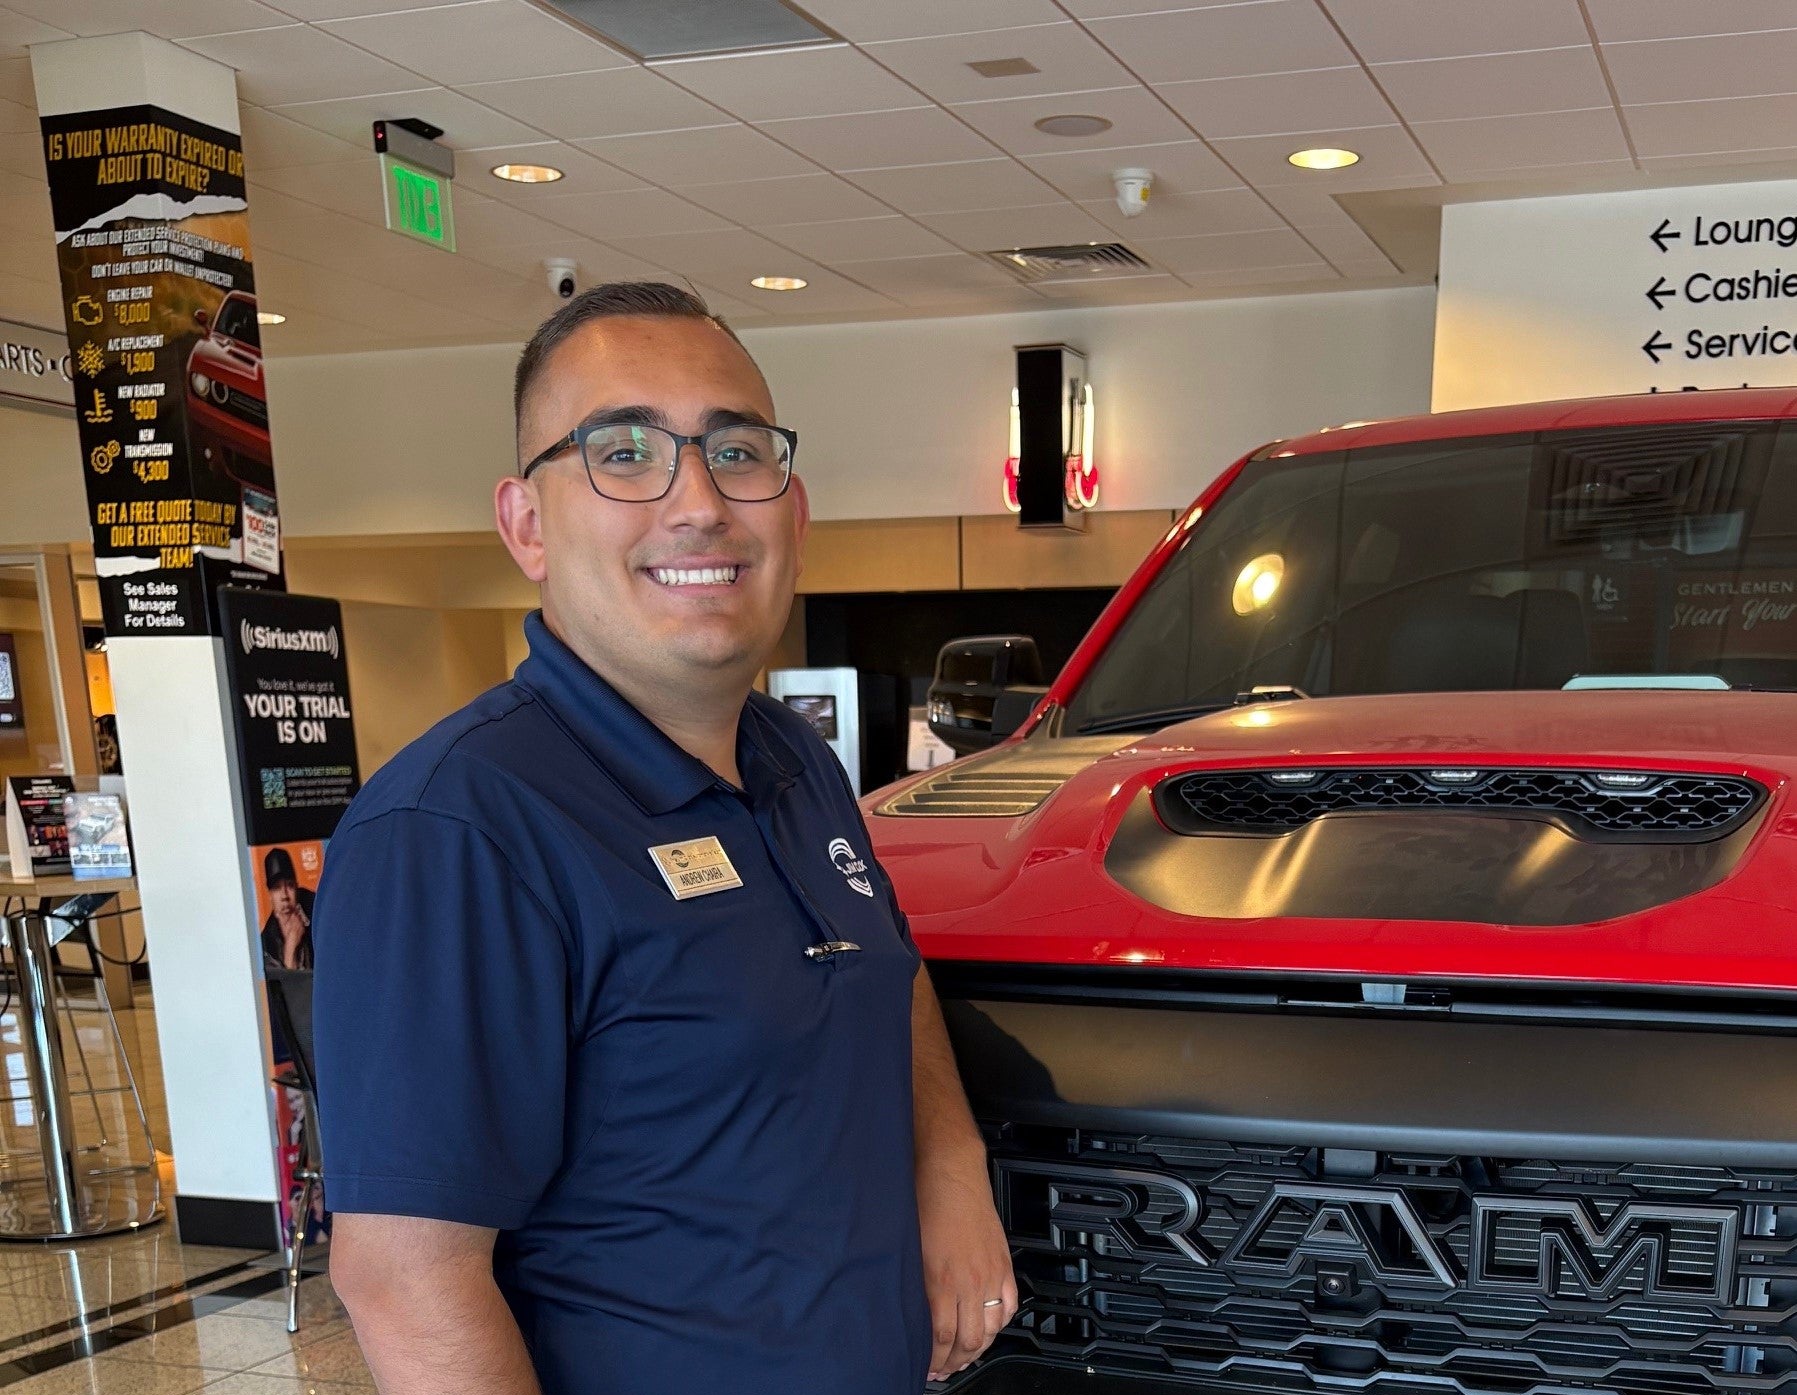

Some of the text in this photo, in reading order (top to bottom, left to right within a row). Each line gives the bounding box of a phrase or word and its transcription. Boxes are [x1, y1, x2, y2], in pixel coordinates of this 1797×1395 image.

[49, 123, 244, 178] IS YOUR WARRANTY EXPIRED OR
[97, 153, 209, 193] ABOUT TO EXPIRE?
[71, 233, 86, 248] ASK
[123, 227, 156, 243] EXTENDED
[149, 258, 163, 273] CAR
[114, 302, 150, 326] $8,000
[1685, 325, 1797, 360] Servic
[121, 351, 155, 375] $1,900
[118, 385, 134, 399] NEW
[130, 399, 157, 420] $900
[139, 428, 155, 442] NEW
[133, 460, 169, 484] $4,300
[97, 502, 118, 525] GET
[118, 502, 128, 523] A
[130, 500, 155, 523] FREE
[157, 499, 192, 523] QUOTE
[110, 525, 135, 547] OUR
[137, 523, 190, 546] EXTENDED
[192, 522, 231, 549] SERVICE
[160, 546, 194, 569] TEAM!
[123, 582, 178, 596] See Sales
[128, 598, 177, 615] Manager
[124, 613, 186, 628] For Details
[243, 693, 351, 719] YOUR TRIAL
[276, 720, 327, 744] IS ON
[680, 871, 705, 887] ANDREW
[995, 1158, 1741, 1307] RAM
